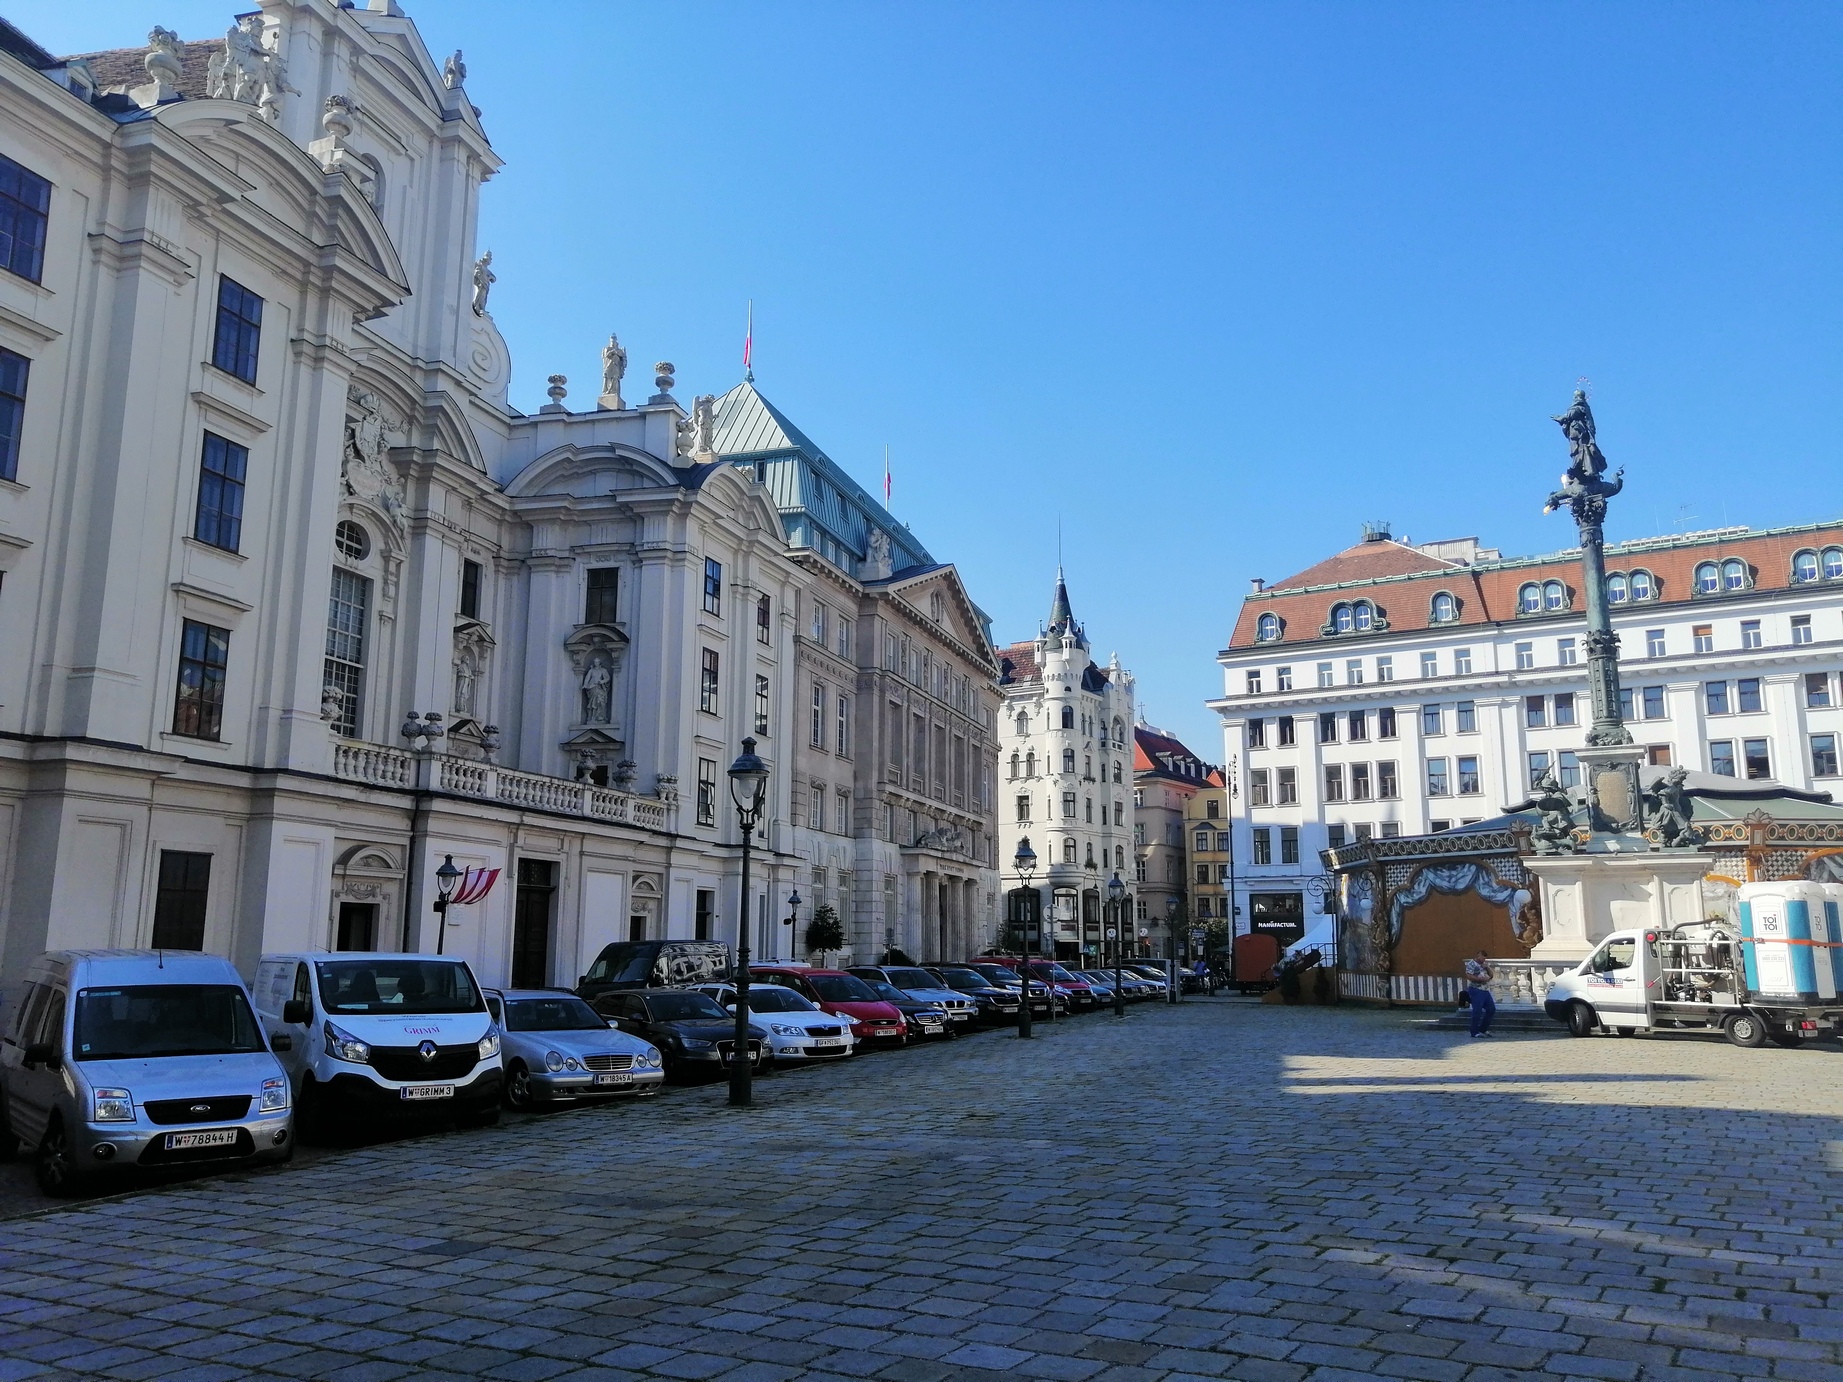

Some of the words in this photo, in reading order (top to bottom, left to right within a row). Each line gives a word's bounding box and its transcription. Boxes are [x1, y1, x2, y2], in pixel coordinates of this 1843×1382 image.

[1762, 914, 1777, 923] TOI
[404, 1026, 440, 1034] GRIMM
[420, 1087, 444, 1096] GRIMM
